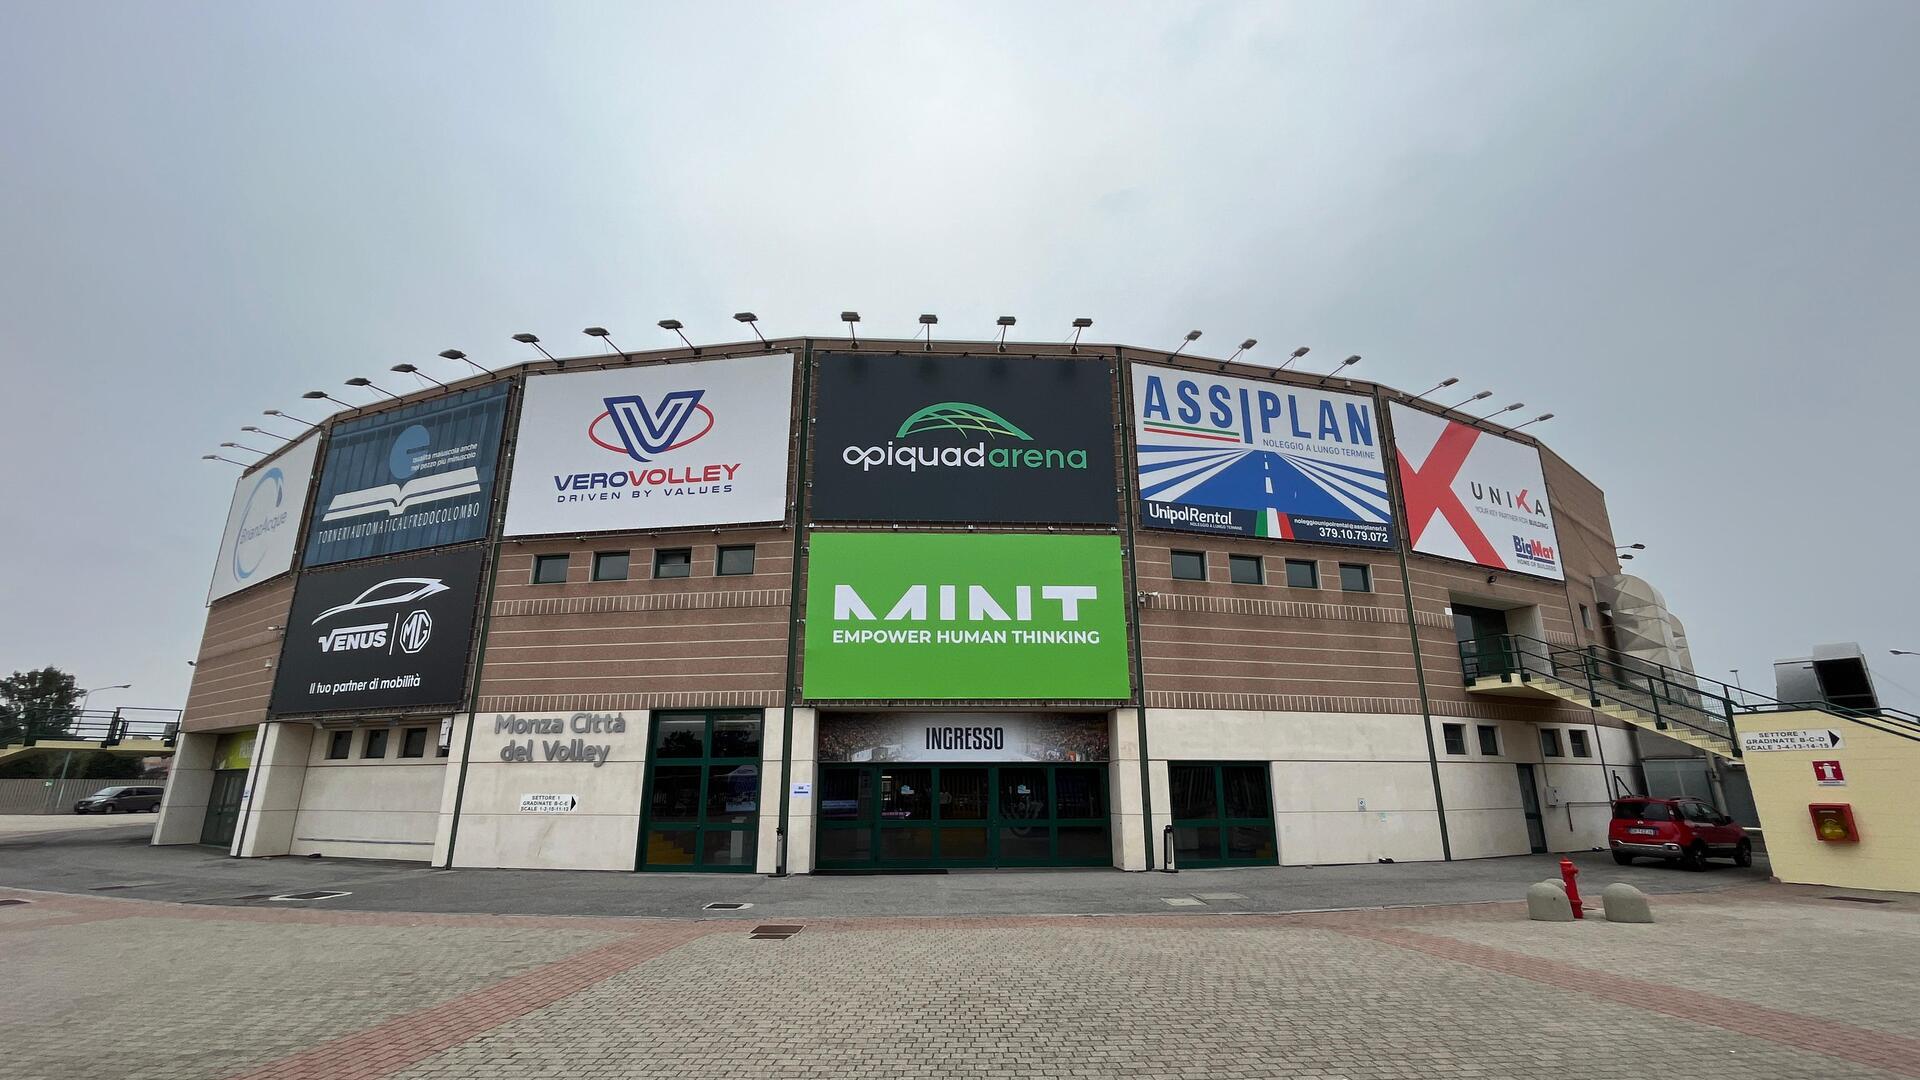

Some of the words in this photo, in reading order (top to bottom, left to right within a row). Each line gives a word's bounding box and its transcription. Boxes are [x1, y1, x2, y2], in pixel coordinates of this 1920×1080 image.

[1143, 375, 1373, 447] ASSIPLAN
[1262, 439, 1304, 451] NOLEGGIO
[1305, 444, 1312, 452] A
[1313, 445, 1340, 455] LUNGO
[1341, 448, 1376, 459] TERMINE
[557, 492, 621, 503] DRIVEN
[632, 489, 652, 499] BY
[664, 484, 733, 497] VALUES
[1471, 481, 1546, 518] UNIKA
[1319, 527, 1389, 543] 379.10.79.072
[1512, 535, 1554, 560] BigMat
[834, 584, 1098, 621] MINT
[318, 623, 389, 652] VENUS
[402, 613, 430, 650] MG
[832, 630, 931, 644] EMPOWER
[937, 630, 1007, 644] HUMAN
[1012, 631, 1100, 645] THINKING
[309, 682, 315, 695] Il
[317, 682, 331, 694] tuo
[332, 679, 368, 696] partner
[369, 677, 379, 690] di
[380, 673, 421, 689] mobilità
[495, 713, 564, 735] Monza
[570, 712, 626, 734] Città
[926, 727, 1004, 750] INGRESSO
[500, 739, 533, 762] del
[542, 739, 610, 768] Volley
